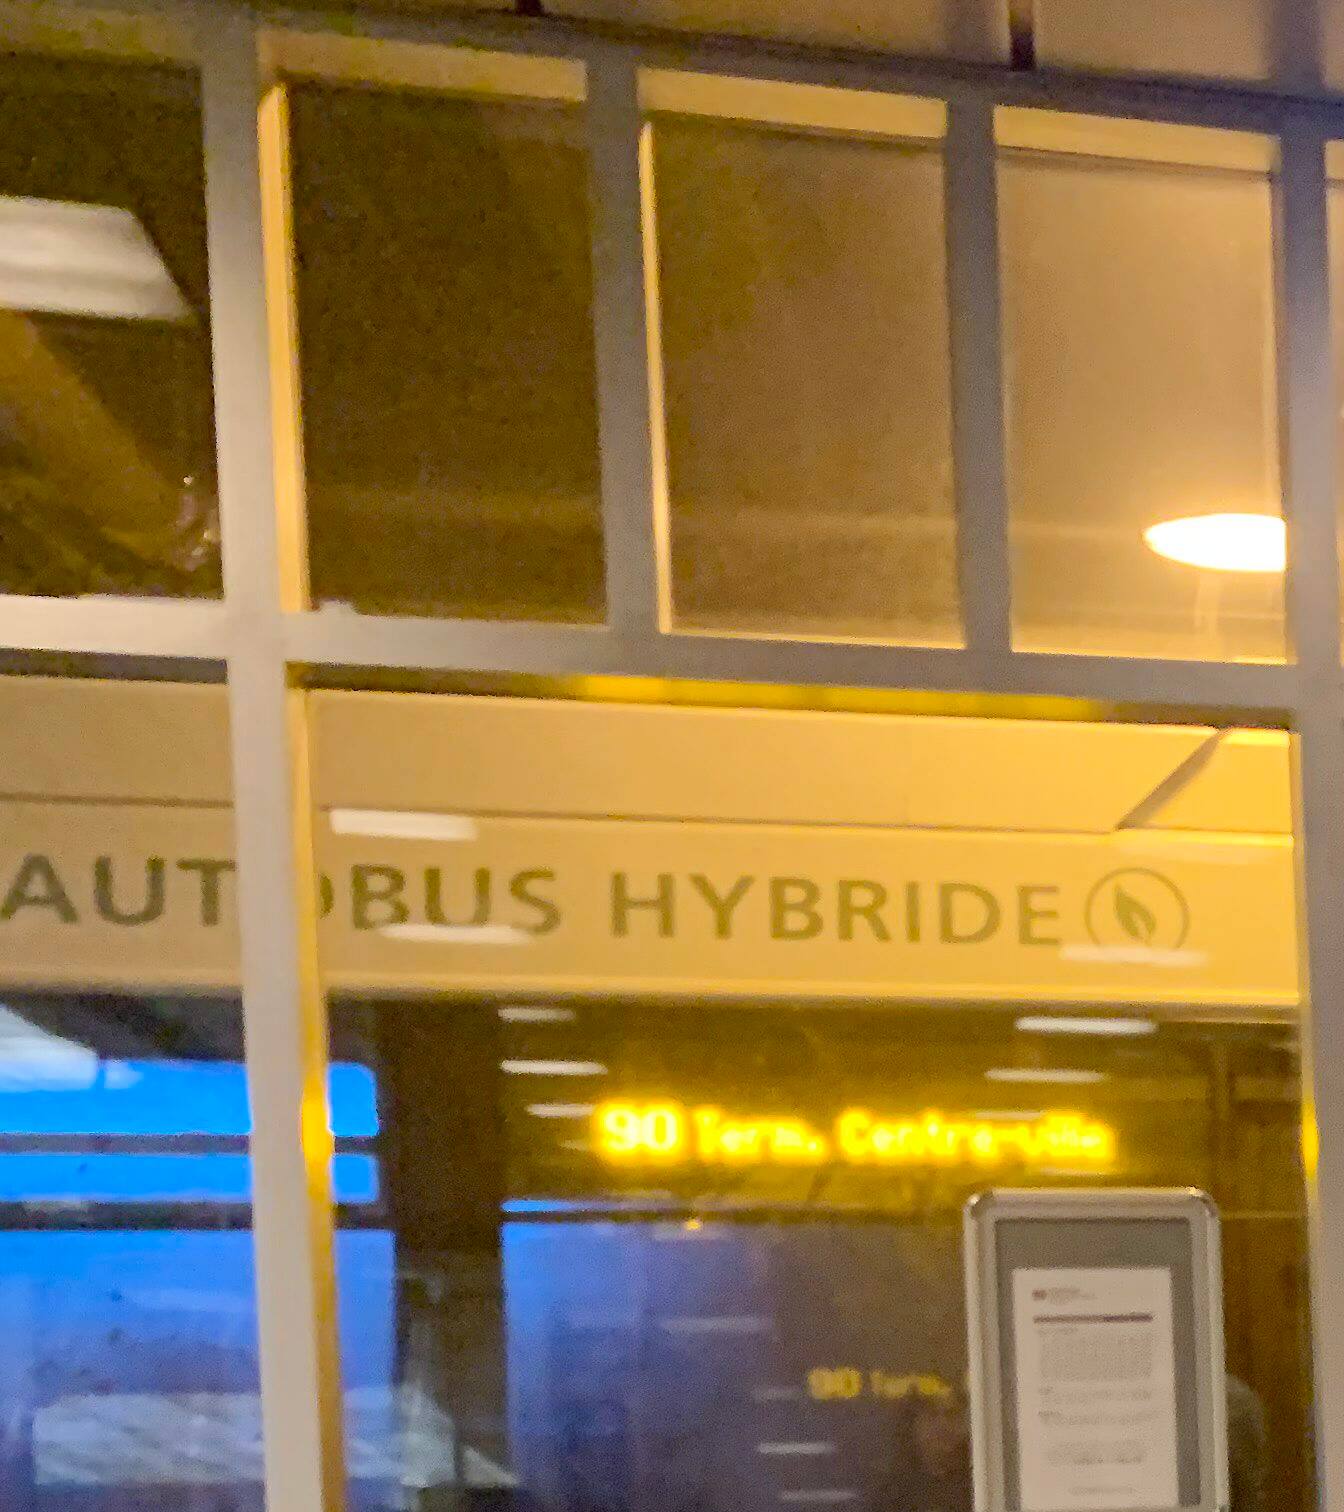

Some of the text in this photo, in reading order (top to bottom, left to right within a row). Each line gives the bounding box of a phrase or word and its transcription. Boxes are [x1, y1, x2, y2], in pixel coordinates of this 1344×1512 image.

[2, 854, 1063, 946] AUTBUS HYBRIDE
[600, 1103, 681, 1158] 90
